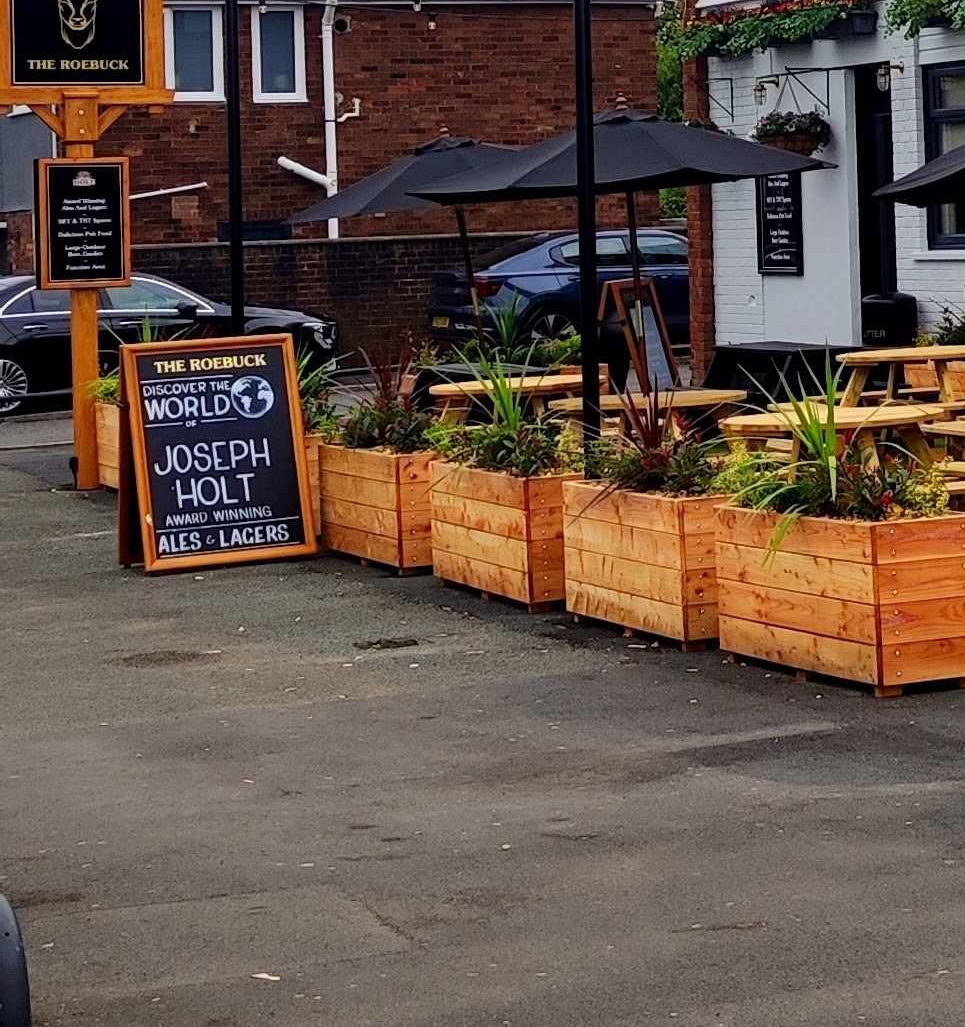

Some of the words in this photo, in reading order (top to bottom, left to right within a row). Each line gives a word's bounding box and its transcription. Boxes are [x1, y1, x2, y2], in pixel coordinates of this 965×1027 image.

[27, 59, 56, 70] THE
[60, 59, 130, 71] ROEBUCK
[153, 359, 187, 373] THE
[189, 353, 267, 371] ROEBUCK
[142, 381, 207, 398] DISCOVER
[211, 380, 231, 391] THE
[144, 394, 230, 421] WORLD
[185, 420, 197, 428] OF
[154, 437, 271, 476] JOSEPH
[175, 473, 255, 508] HOLT
[165, 509, 208, 527] AWARD
[213, 505, 273, 522] WINNING
[158, 532, 201, 554] ALES
[206, 535, 216, 545] &
[219, 524, 290, 547] LAGERS
